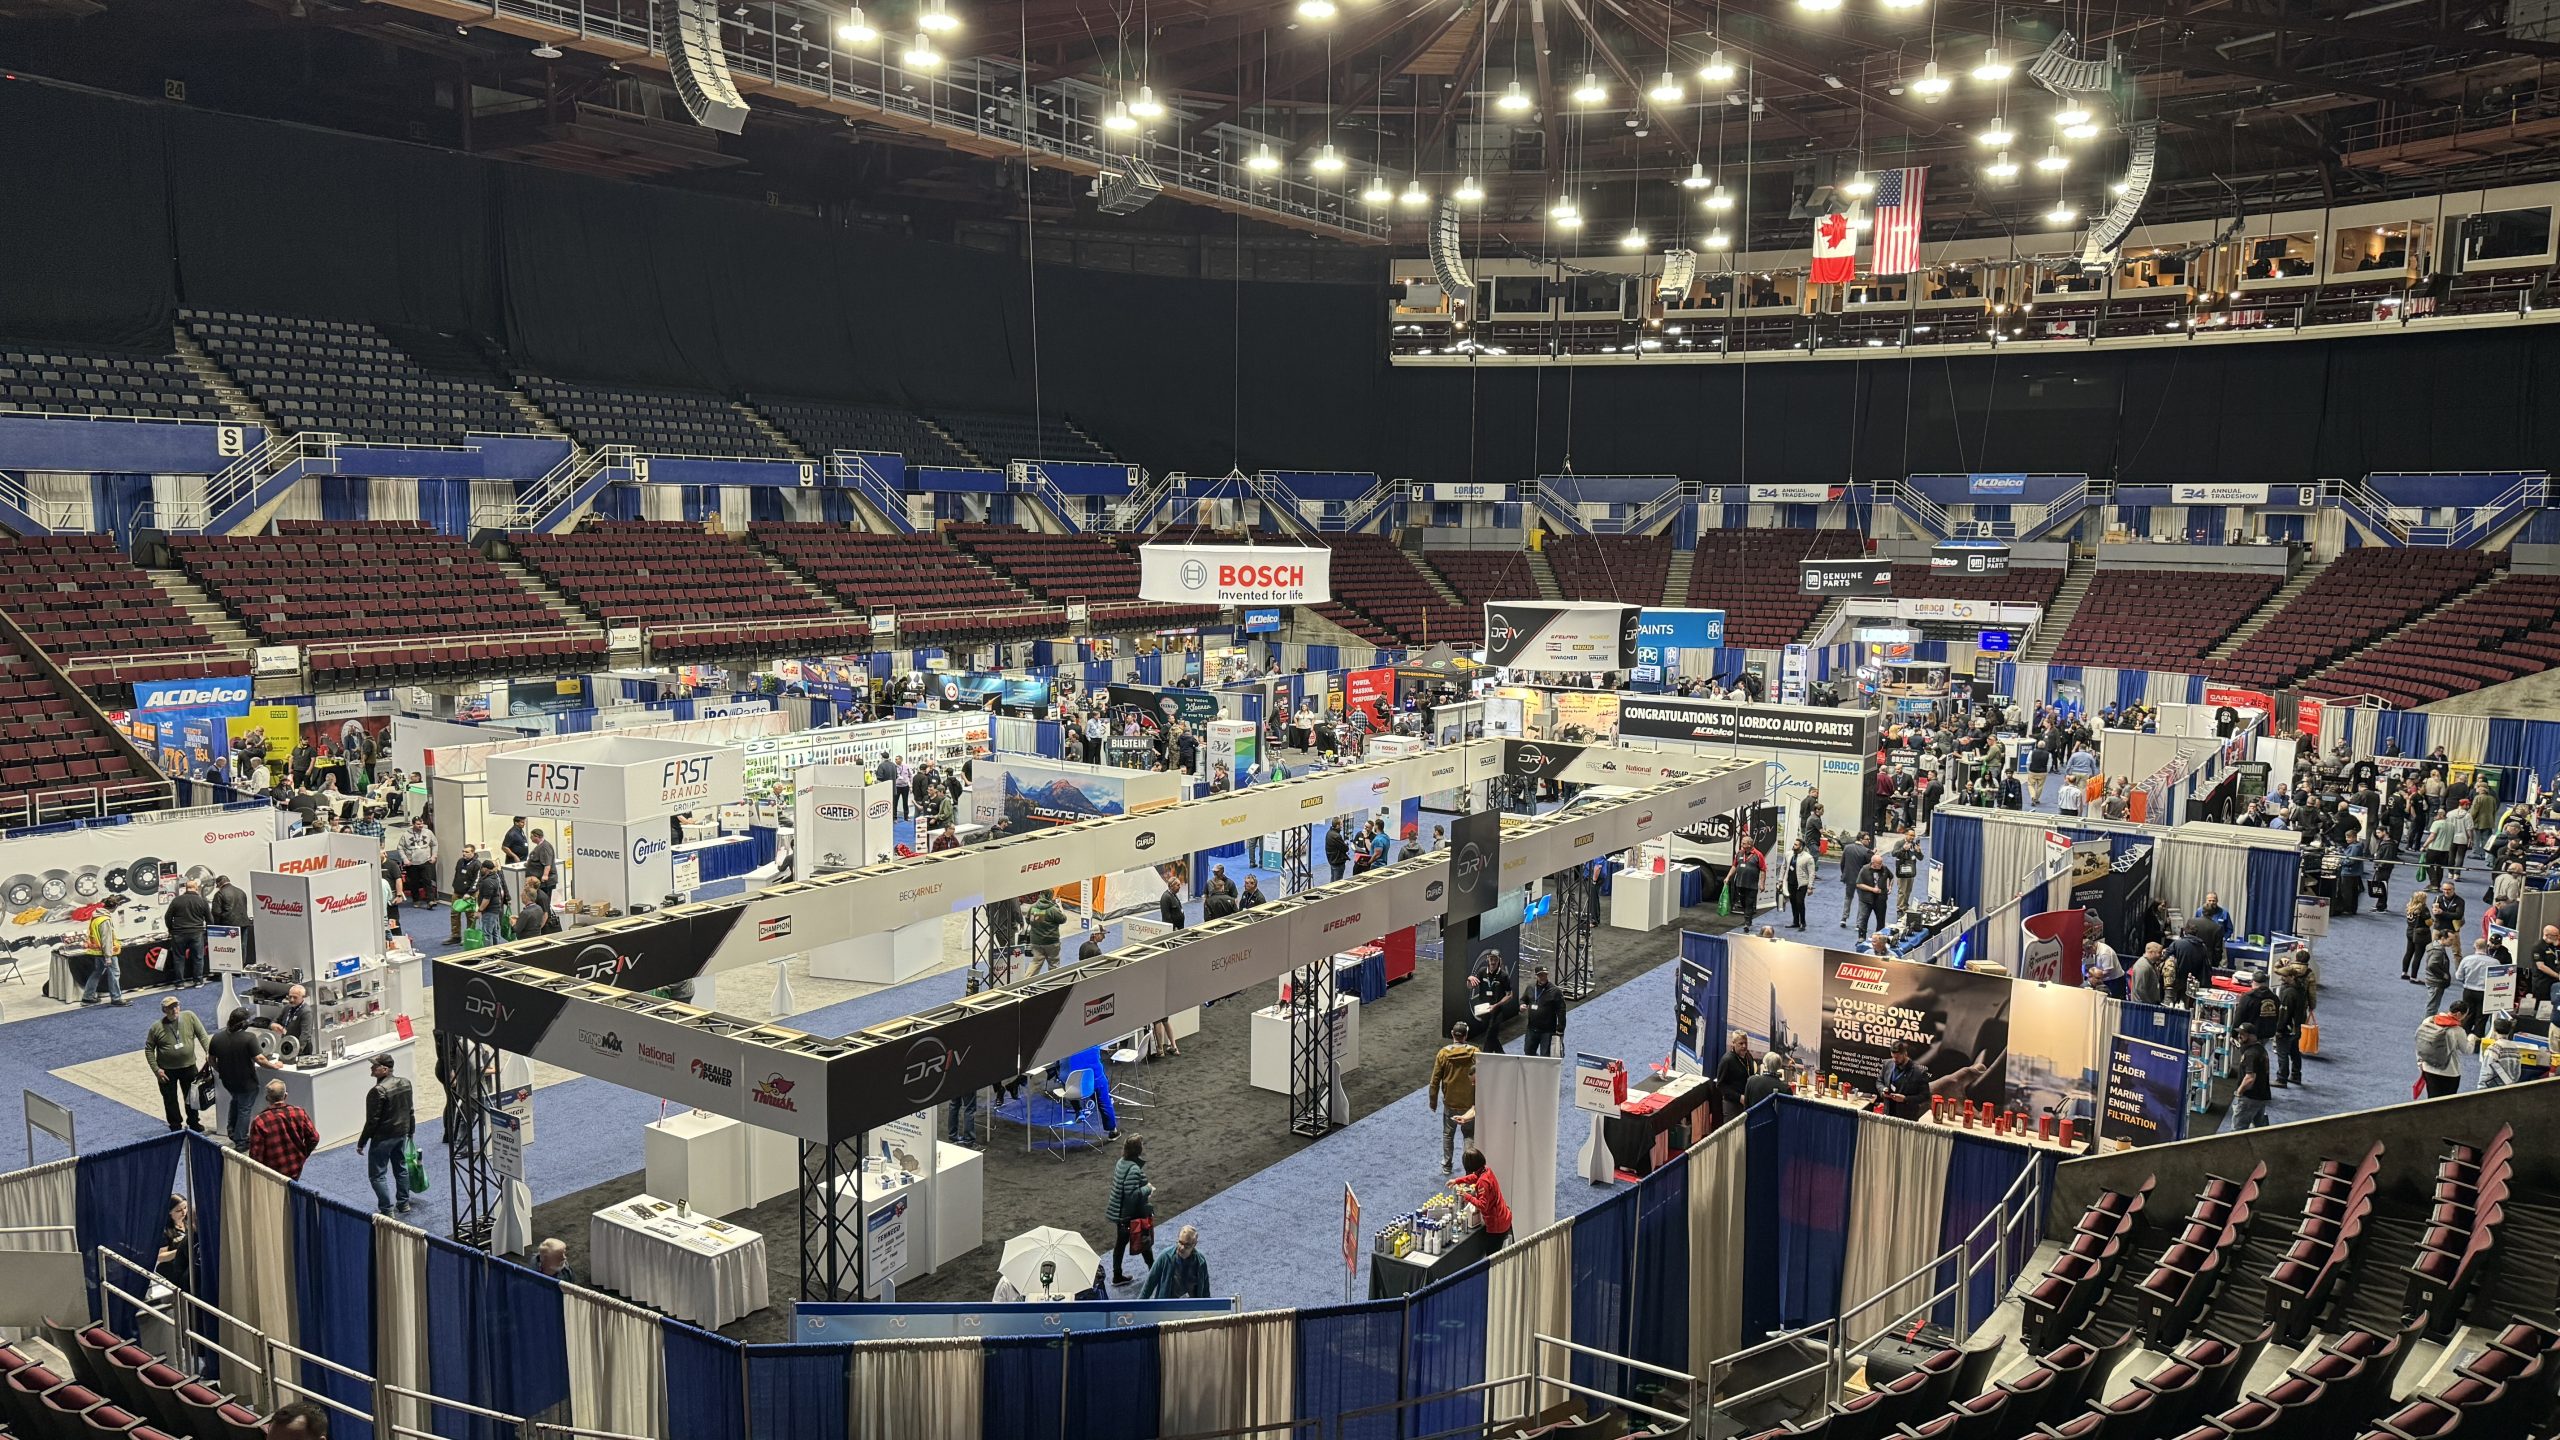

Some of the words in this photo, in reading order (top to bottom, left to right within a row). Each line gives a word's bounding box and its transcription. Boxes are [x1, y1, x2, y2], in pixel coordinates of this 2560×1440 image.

[223, 428, 238, 446] S
[636, 460, 646, 474] T
[802, 466, 812, 478] U
[1129, 468, 1137, 478] W
[1973, 478, 2024, 488] ACDelco
[1414, 486, 1422, 497] Y
[1712, 488, 1719, 499] Z
[1757, 488, 1778, 498] 34
[2181, 488, 2206, 499] 34
[2303, 488, 2312, 500] B
[1980, 522, 1990, 533] A
[1218, 565, 1304, 587] BOSCH
[1823, 572, 1863, 581] GENUINE
[1823, 579, 1851, 587] PARTS
[1218, 589, 1269, 601] Invented
[1271, 590, 1287, 600] for
[1289, 589, 1303, 600] life
[1247, 614, 1279, 625] ACDelco
[145, 687, 247, 708] ACDelco
[1625, 706, 1719, 725] CONGRATULATIONS
[1720, 714, 1735, 726] TO
[1739, 716, 1781, 731] LORDCO
[1783, 720, 1813, 734] AUTO
[1815, 723, 1854, 737] PARTS!
[1691, 726, 1733, 737] ACDelco
[1111, 738, 1147, 748] BILSTEIN
[1625, 764, 1652, 774] National
[1823, 760, 1859, 771] LORDCO
[2378, 758, 2417, 768] LOCTITE
[526, 791, 580, 805] BRANDS
[661, 783, 709, 802] BRANDS
[1302, 797, 1322, 808] MOOG
[820, 806, 853, 818] CARTER
[869, 803, 889, 817] CARTER
[1034, 806, 1075, 818] MOVING
[218, 829, 256, 842] brembo
[1136, 836, 1155, 848] GURUS
[1575, 833, 1594, 847] MOOG
[576, 847, 621, 861] CARDONE
[632, 837, 667, 866] Centric
[279, 855, 329, 874] FRAM
[256, 894, 304, 913] Raybestos
[315, 891, 368, 913] Raybestos
[760, 921, 791, 935] CHAMPION
[213, 944, 236, 954] Autolite
[1840, 964, 1885, 982] BALDWIN
[1855, 981, 1884, 993] FILTERS
[1086, 1002, 1114, 1018] CHAMPION
[1834, 997, 1886, 1013] YOU'RE
[1888, 1006, 1926, 1022] ONLY
[1833, 1008, 1854, 1020] AS
[1855, 1011, 1899, 1028] GOOD
[1900, 1018, 1920, 1032] AS
[1832, 1027, 1863, 1042] YOU
[1833, 1018, 1860, 1032] THE
[1863, 1021, 1935, 1046] COMPANY
[638, 1042, 675, 1065] National
[703, 1062, 733, 1079] SEALED
[1843, 1050, 1858, 1058] need
[2113, 1051, 2131, 1064] THE
[2150, 1050, 2178, 1062] RACOR
[2112, 1063, 2146, 1079] LEADER
[703, 1071, 732, 1088] POWER
[1585, 1076, 1611, 1089] BALDWIN
[2111, 1074, 2121, 1085] IN
[1594, 1087, 1611, 1095] FILTERS
[2109, 1085, 2144, 1102] MARINE
[2108, 1097, 2141, 1114] ENGINE
[2107, 1108, 2157, 1132] FILTRATION
